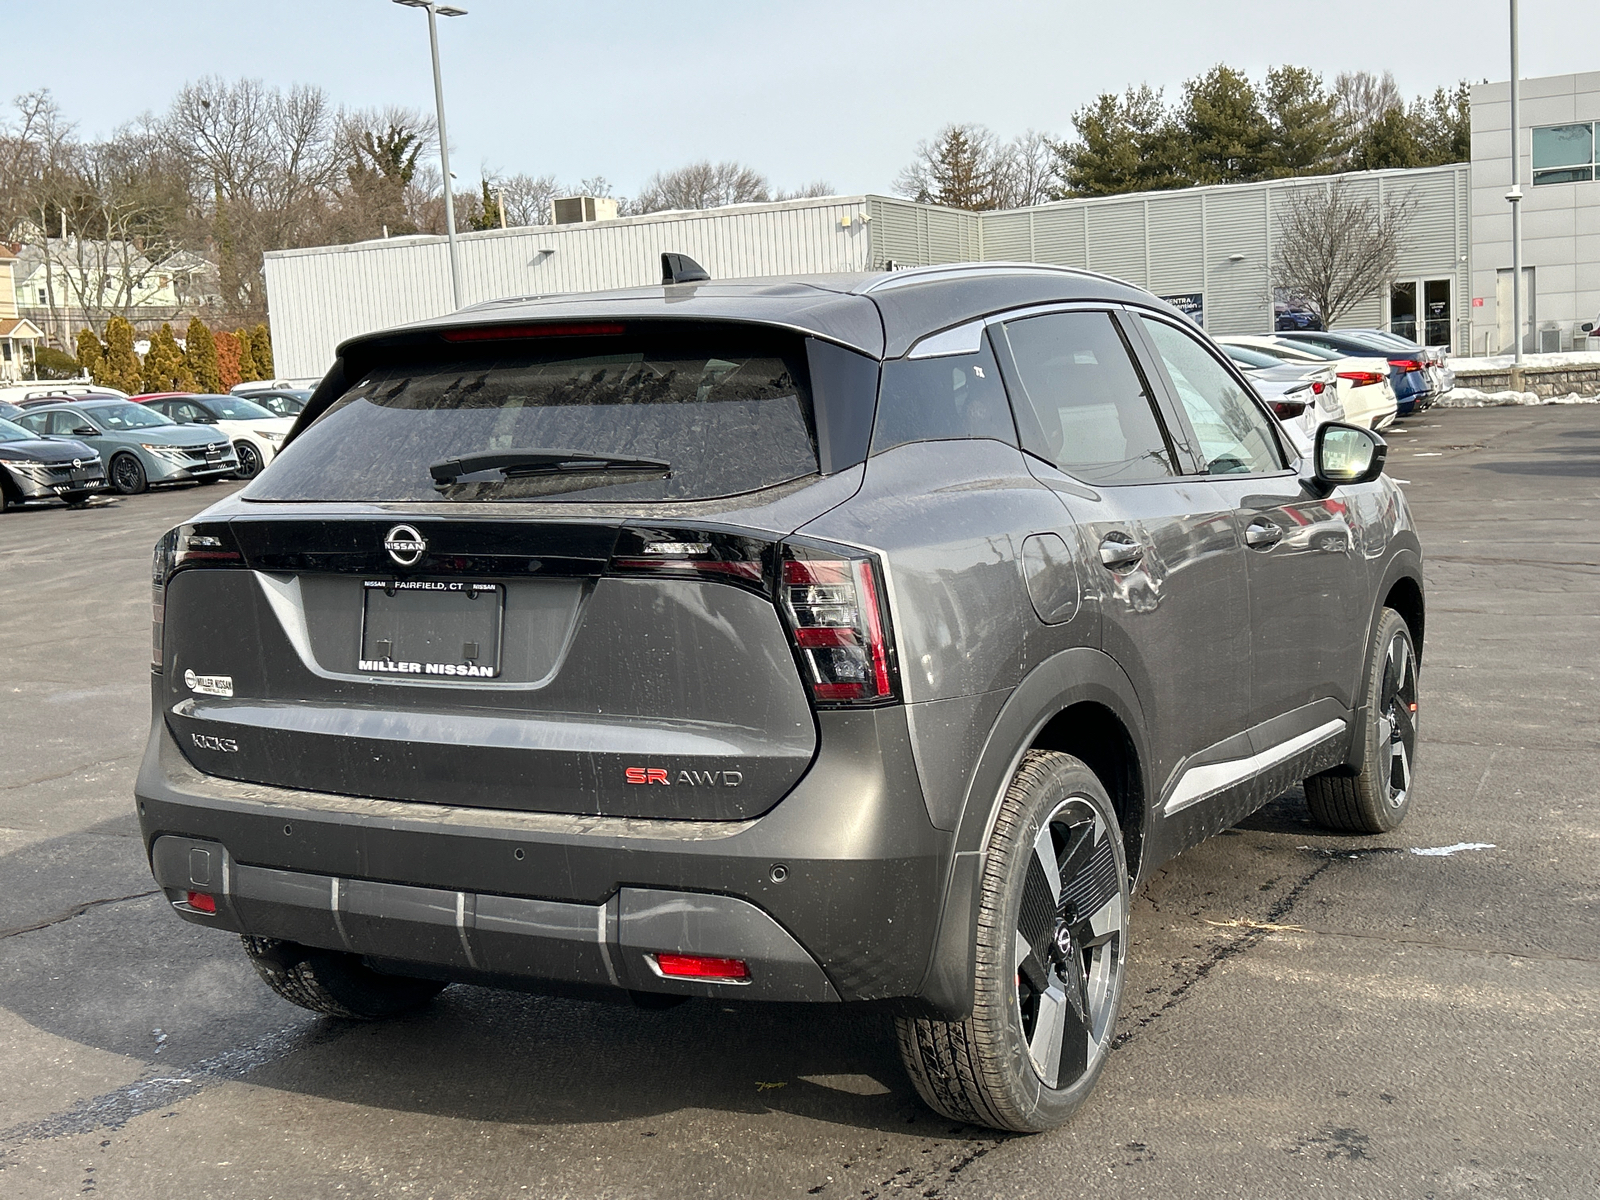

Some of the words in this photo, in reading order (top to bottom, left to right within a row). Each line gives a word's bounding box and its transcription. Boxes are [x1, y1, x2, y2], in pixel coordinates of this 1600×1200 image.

[384, 542, 424, 550] NISSAN
[394, 581, 447, 591] FAIRFIELD,
[358, 660, 421, 673] MILLER
[425, 664, 494, 677] NISSAN
[215, 679, 232, 690] NISSAN
[191, 733, 239, 752] KICKS
[625, 767, 671, 785] SR
[676, 770, 743, 786] AWD
